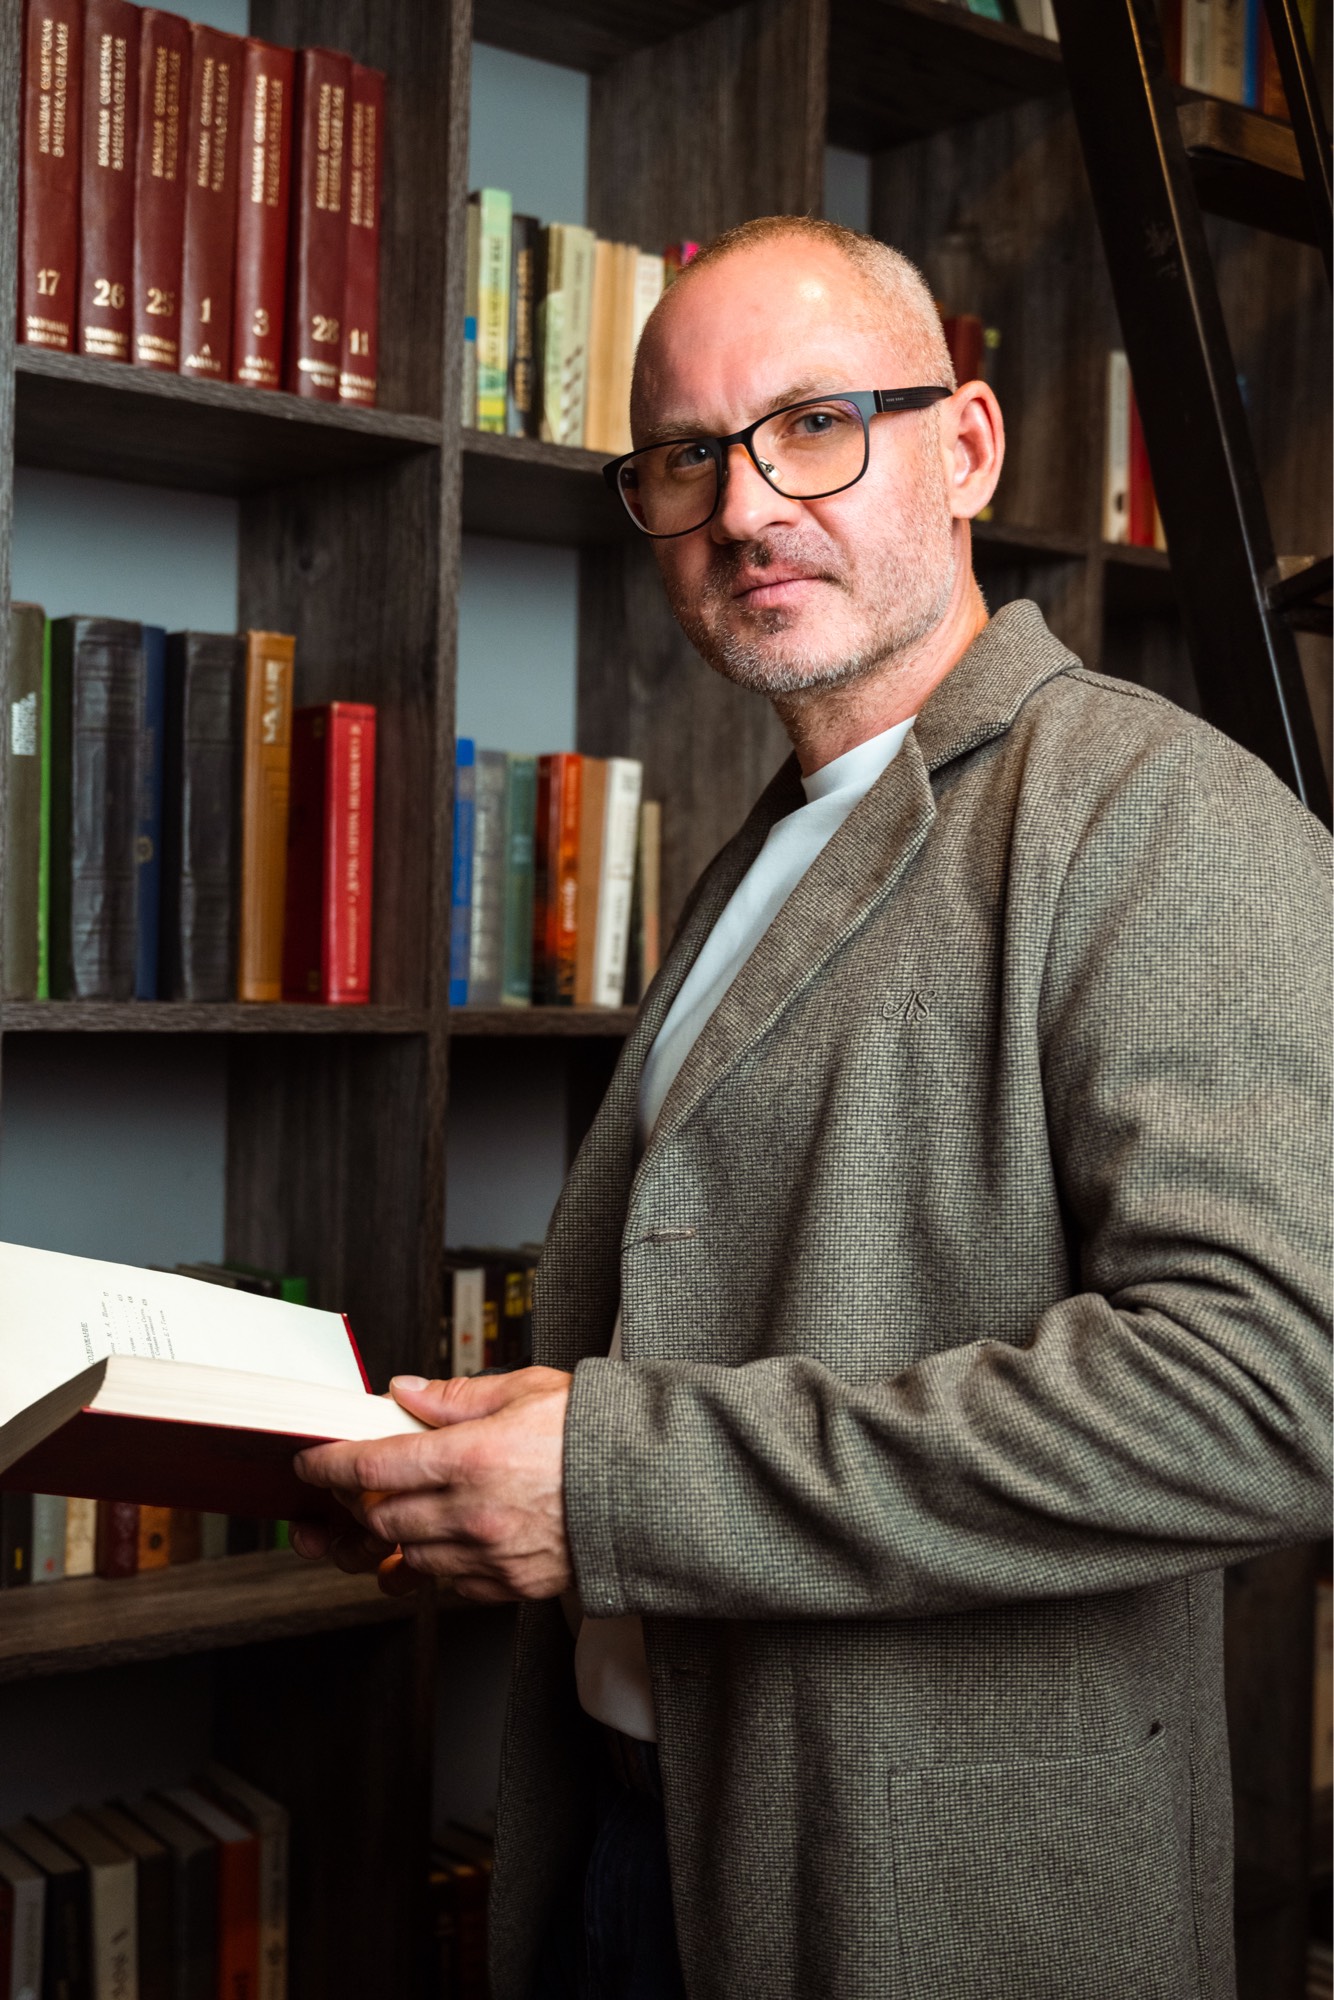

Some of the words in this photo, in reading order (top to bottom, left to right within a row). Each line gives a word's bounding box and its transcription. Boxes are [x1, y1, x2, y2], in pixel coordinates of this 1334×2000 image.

[40, 18, 53, 90] СОВЕТСКАЯ
[99, 33, 113, 105] СОВЕТСКАЯ
[52, 22, 69, 158] ЭНЦИКЛОПЕДИЯ
[112, 37, 127, 171] ЭНЦИКЛОПЕДИЯ
[39, 94, 51, 153] БОЛЬШАЯ
[98, 108, 111, 167] БОЛЬШАЯ
[37, 267, 60, 297] 17
[93, 278, 126, 310] 26
[145, 287, 175, 317] 25
[200, 297, 211, 324] 1
[252, 308, 270, 337] 3
[311, 314, 340, 345] 28
[350, 327, 369, 356] 11
